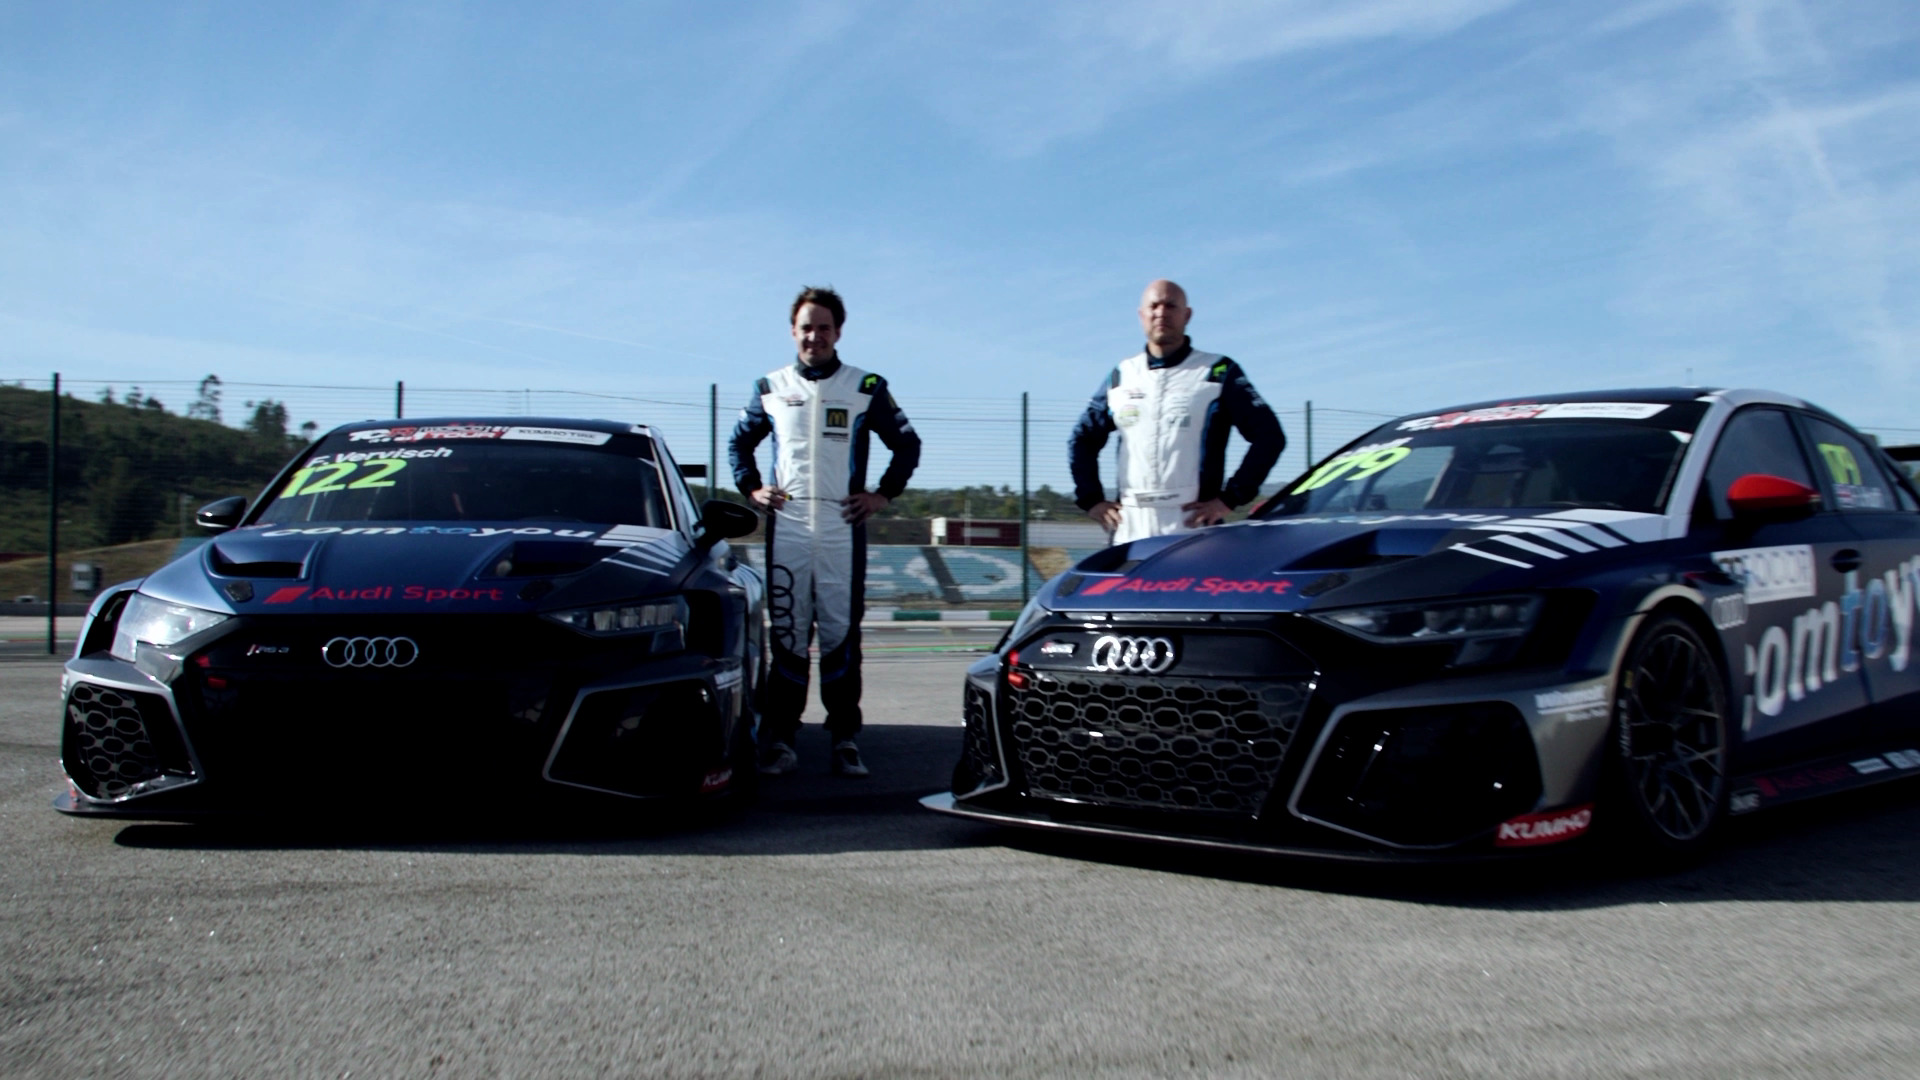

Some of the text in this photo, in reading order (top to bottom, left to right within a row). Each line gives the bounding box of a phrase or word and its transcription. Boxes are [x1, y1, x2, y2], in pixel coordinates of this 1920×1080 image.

[334, 447, 453, 462] Vervisch
[279, 458, 407, 498] 122
[261, 526, 596, 538] comtoyou
[308, 585, 504, 603] Audi Sport
[1116, 577, 1293, 596] Audi Sport
[1741, 554, 1920, 732] omtoy
[1498, 808, 1593, 840] KUMHO
